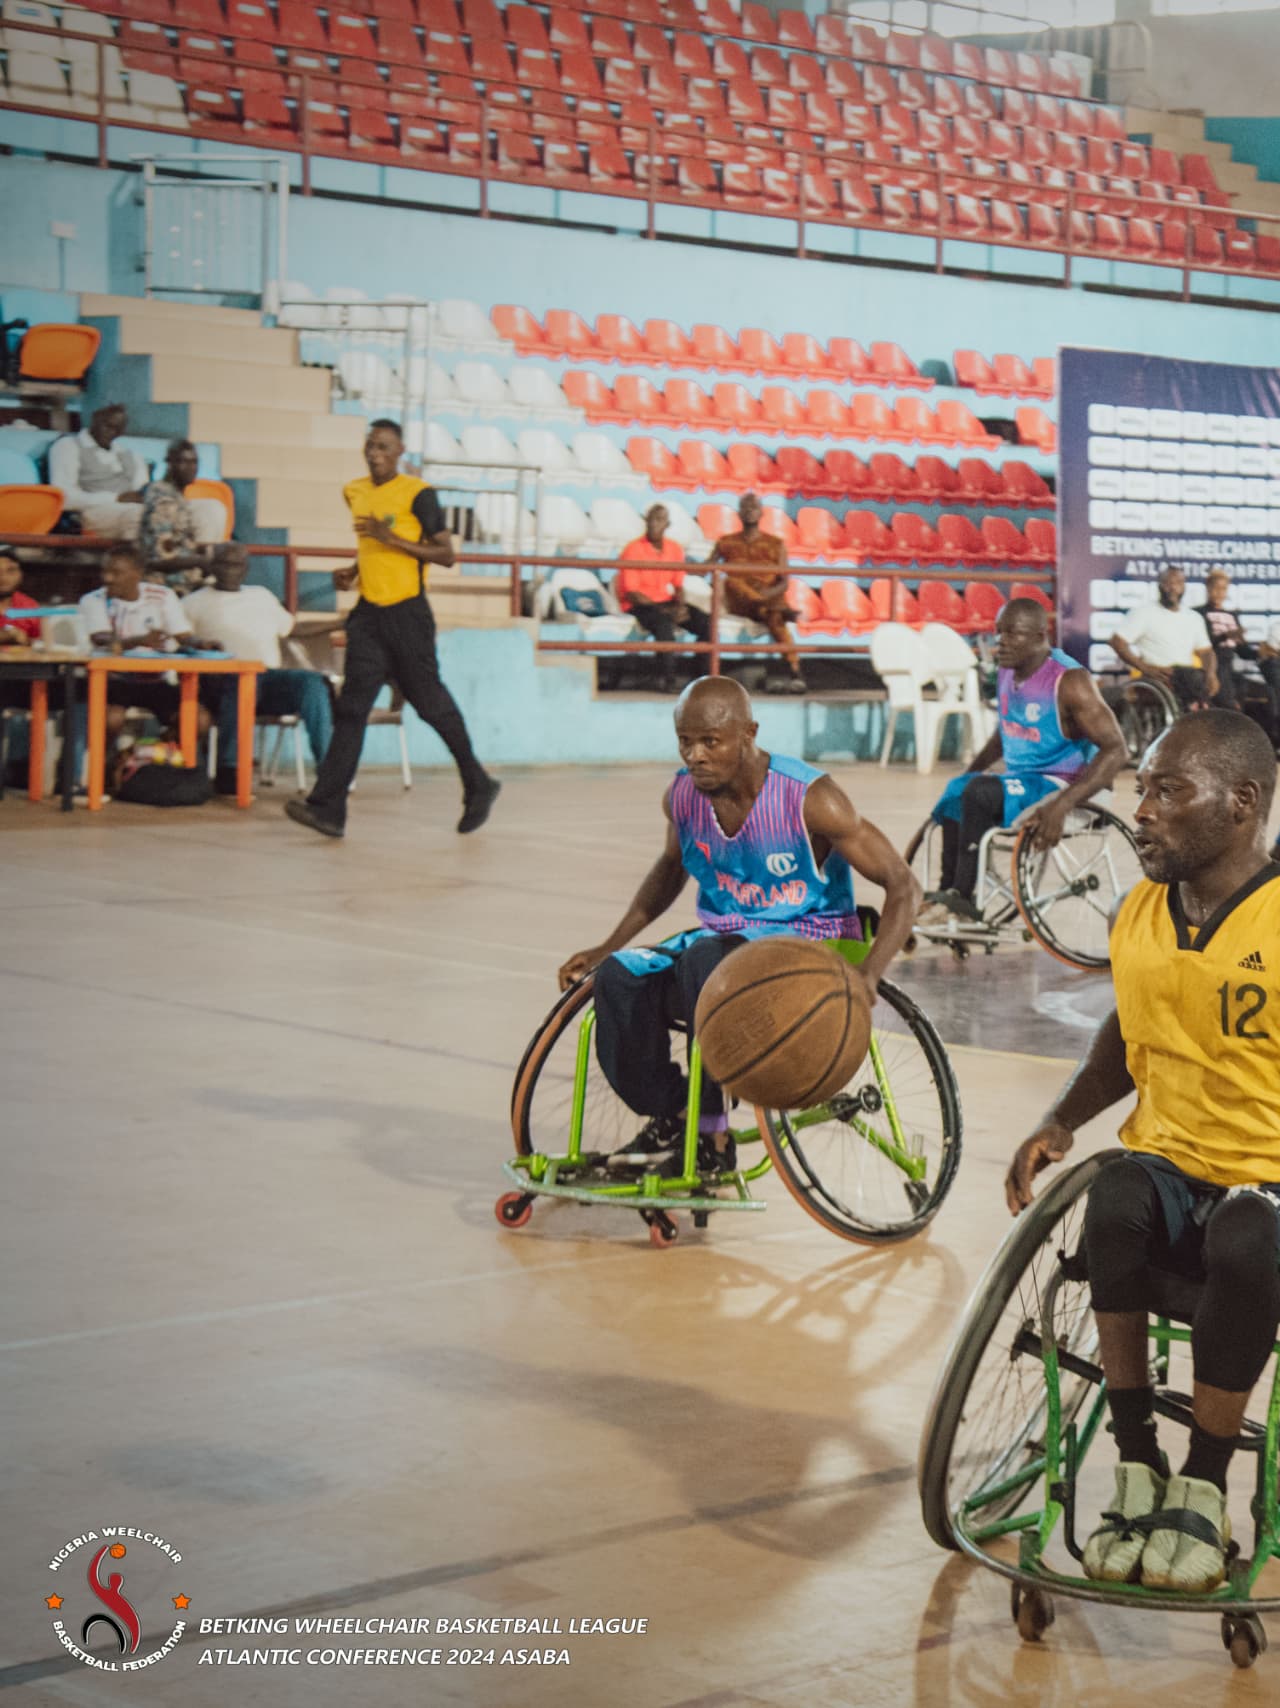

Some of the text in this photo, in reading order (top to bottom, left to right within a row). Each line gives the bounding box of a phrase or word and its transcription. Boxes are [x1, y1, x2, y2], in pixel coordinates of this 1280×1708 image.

[1091, 535, 1164, 557] BETKING
[1163, 538, 1271, 561] WHEELCHAIR
[1217, 981, 1270, 1039] 12
